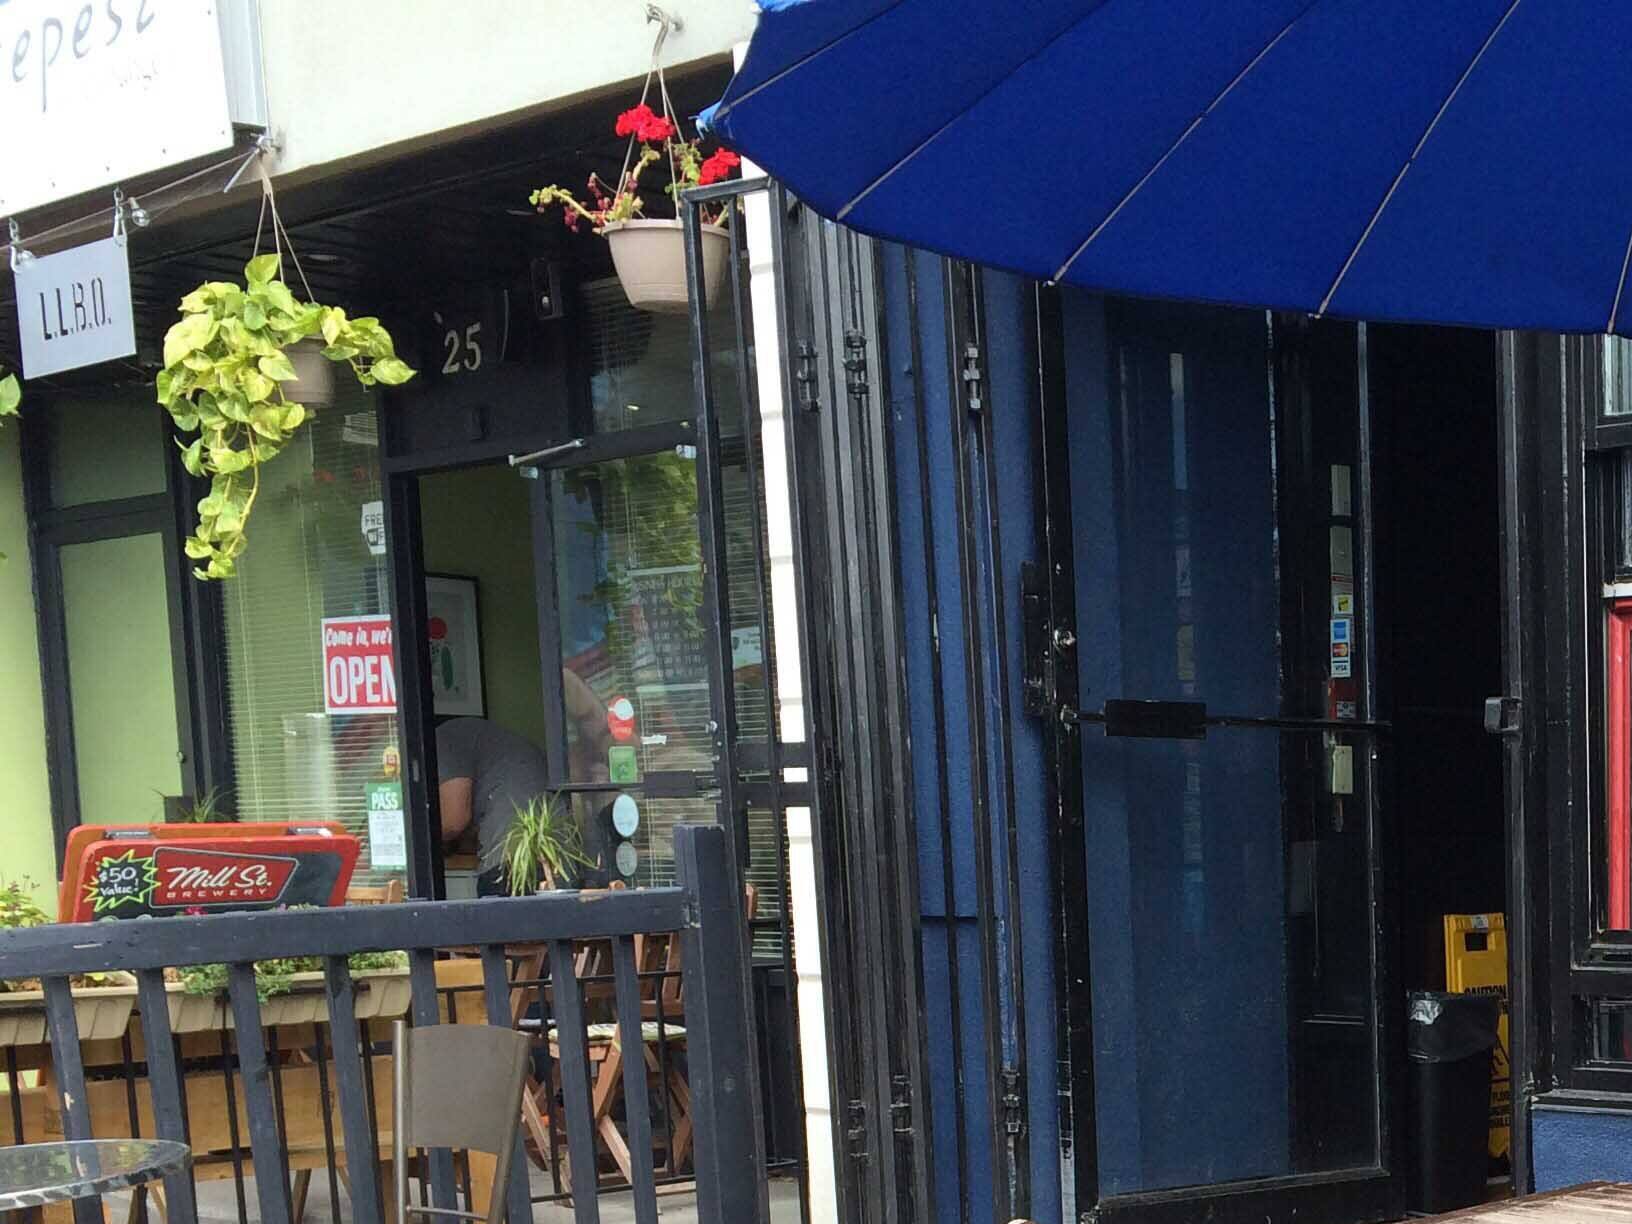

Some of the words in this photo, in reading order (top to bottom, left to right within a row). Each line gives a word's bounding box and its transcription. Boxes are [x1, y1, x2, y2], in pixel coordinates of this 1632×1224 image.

[1334, 663, 1347, 672] VISA
[330, 655, 397, 705] OPEN
[371, 791, 399, 811] PASS
[166, 865, 238, 889] Mill
[234, 864, 273, 888] St.
[166, 888, 268, 899] BREWERY
